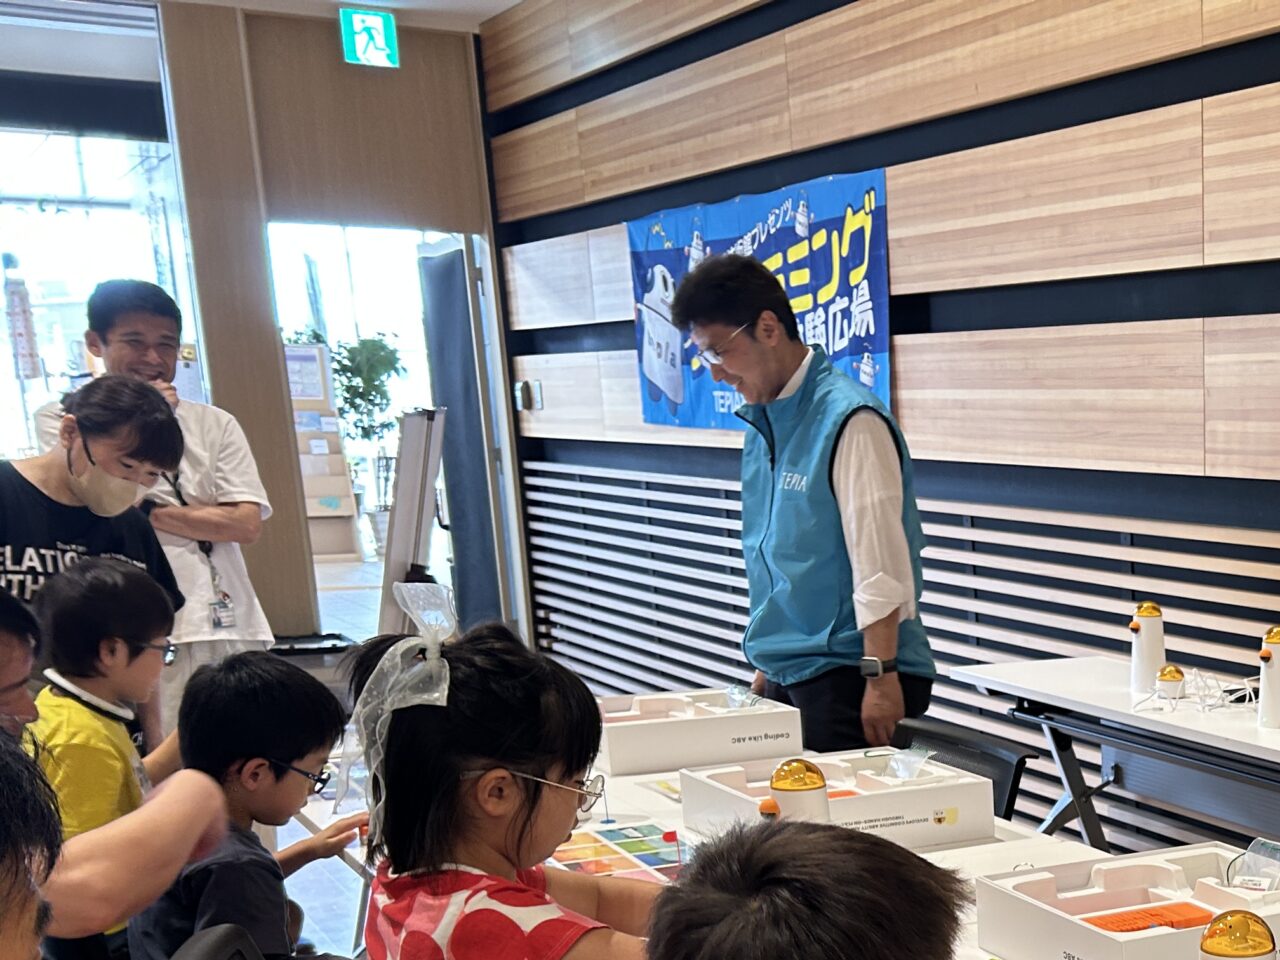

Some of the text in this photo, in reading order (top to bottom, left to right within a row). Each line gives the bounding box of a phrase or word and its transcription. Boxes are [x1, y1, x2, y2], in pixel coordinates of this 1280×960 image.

[782, 472, 807, 492] TEPIA
[731, 736, 747, 744] ABC
[763, 732, 790, 742] Coding
